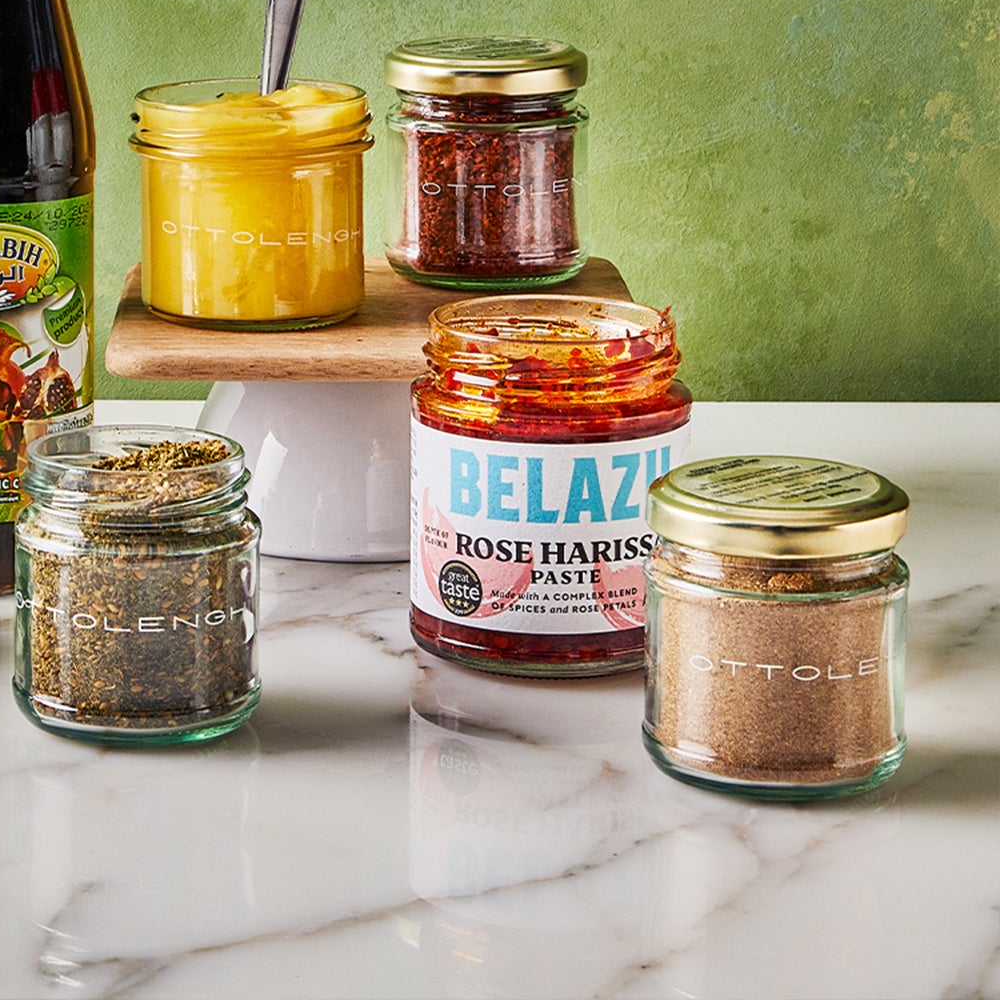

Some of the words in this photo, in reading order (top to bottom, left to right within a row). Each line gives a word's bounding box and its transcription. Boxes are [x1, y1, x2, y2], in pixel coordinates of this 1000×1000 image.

[455, 532, 534, 564] ROSE
[448, 571, 470, 584] great
[531, 569, 601, 585] PASTE
[441, 578, 480, 601] taste
[490, 589, 515, 600] Made
[518, 591, 540, 601] with
[543, 593, 550, 601] A
[553, 591, 605, 602] COMPLEX
[608, 587, 638, 599] BLEND
[492, 602, 505, 611] OF
[508, 603, 546, 614] SPICES
[549, 604, 569, 614] and
[572, 604, 599, 613] ROSE
[603, 599, 637, 612] PETALS
